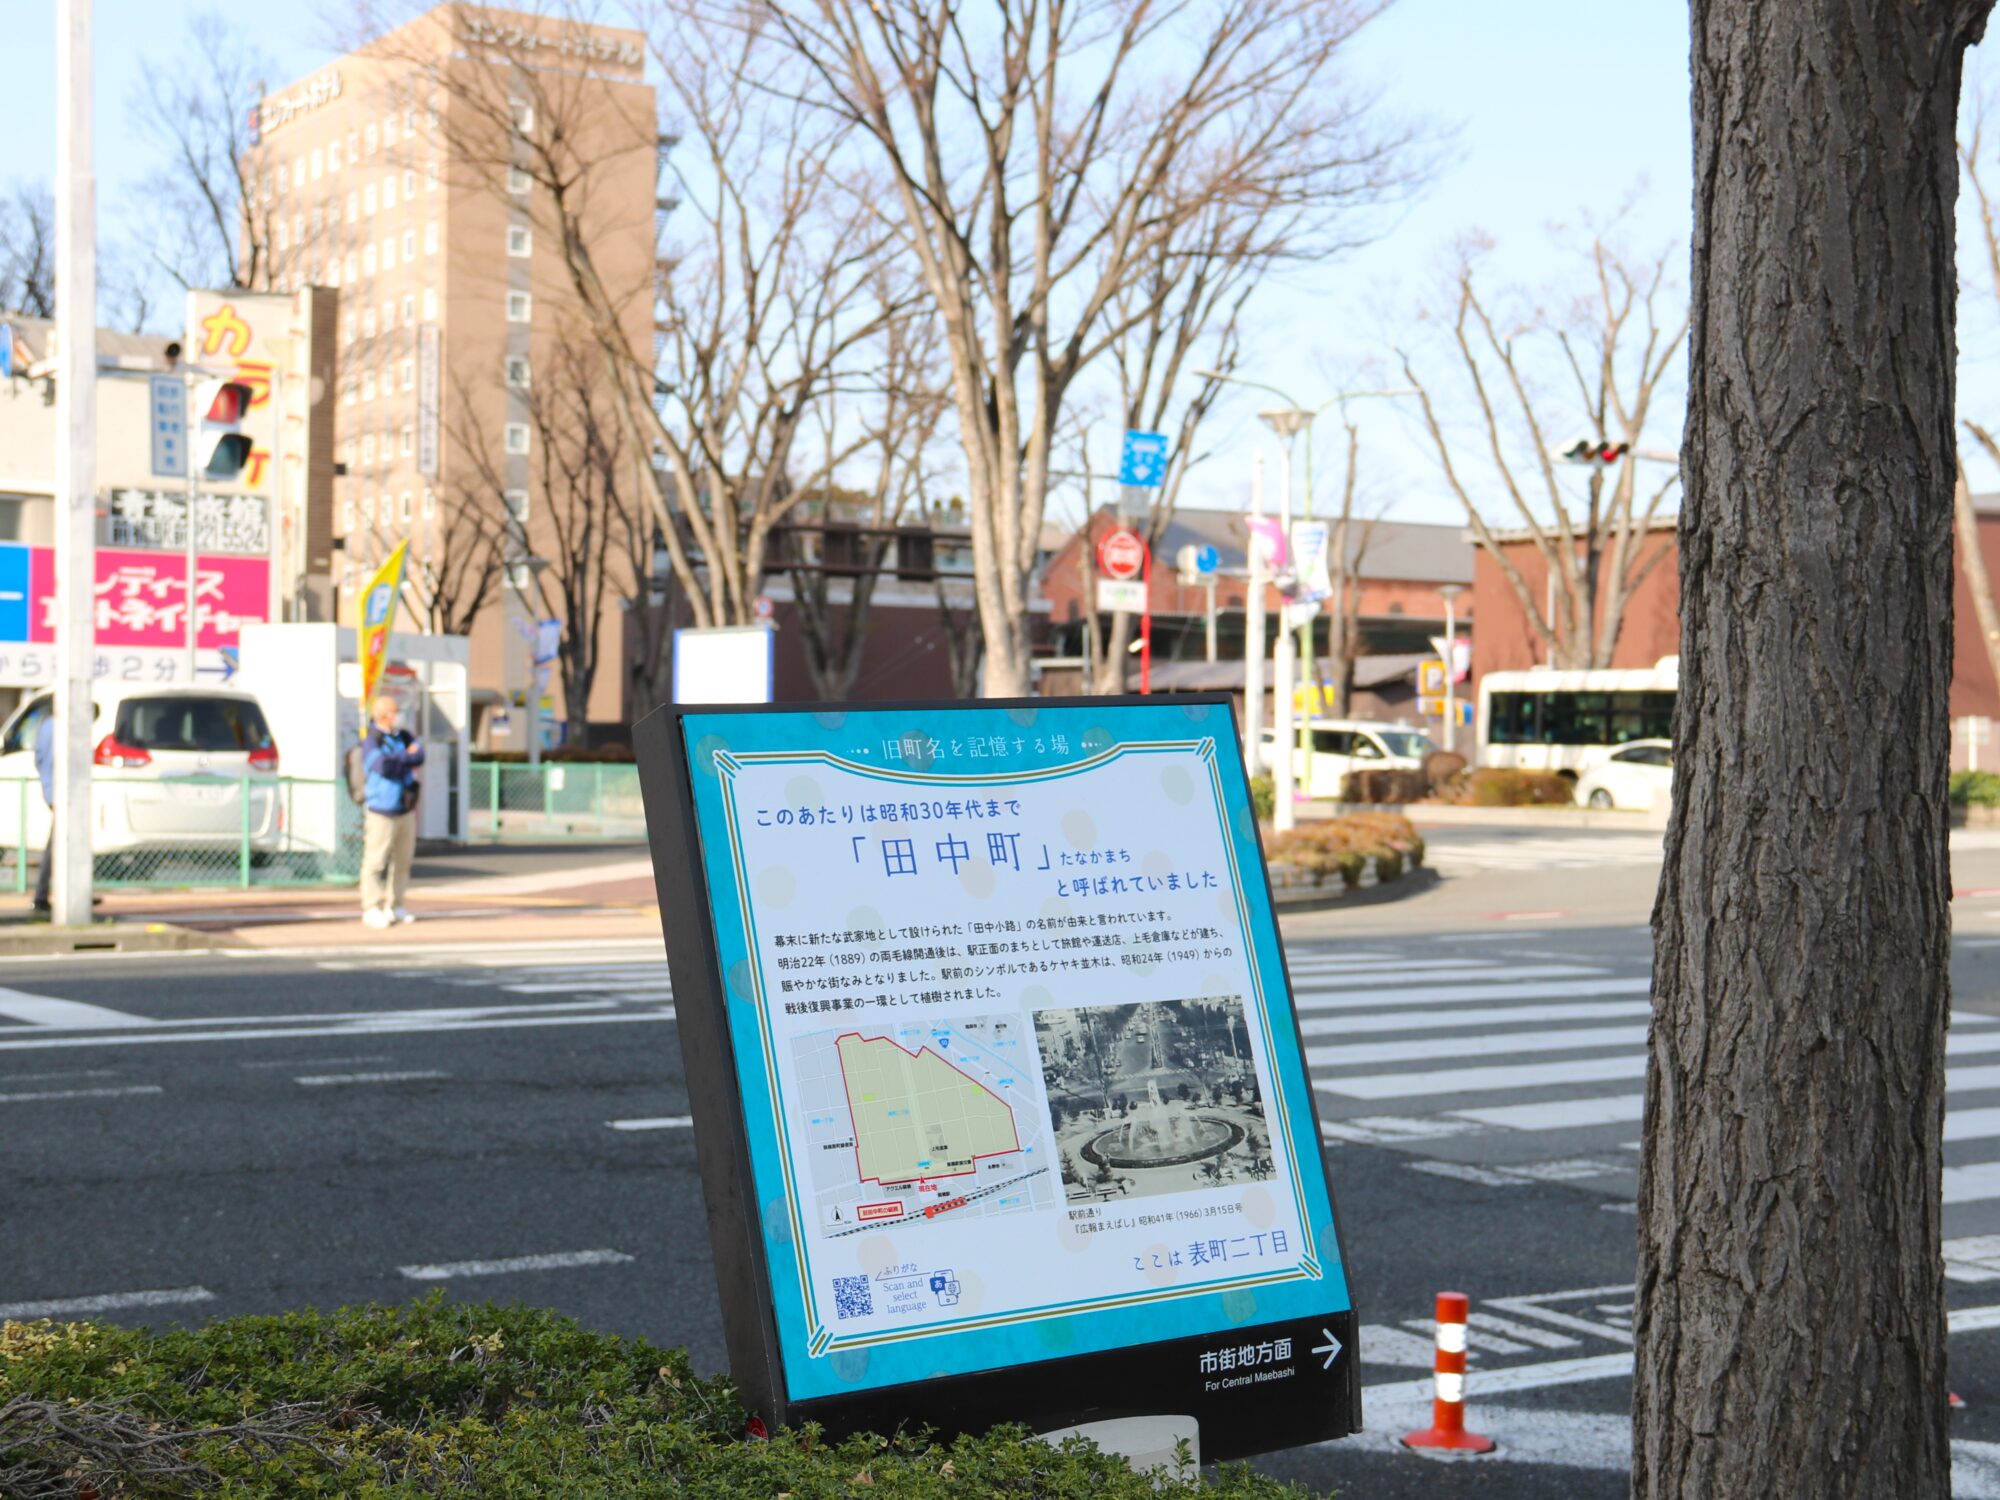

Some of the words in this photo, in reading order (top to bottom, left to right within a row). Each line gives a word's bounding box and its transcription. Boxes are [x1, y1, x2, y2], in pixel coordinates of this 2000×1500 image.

[202, 304, 275, 487] カラ
[881, 734, 1070, 761] 旧町名を記憶する場
[756, 799, 1022, 827] このあたりは昭和30年代まで
[1060, 848, 1131, 867] たなかまち
[1057, 870, 1219, 898] と呼ばれていました
[1068, 1207, 1102, 1220] 駅前通り
[883, 1263, 918, 1275] ふりがな
[883, 1281, 905, 1293] Scan
[908, 1278, 924, 1289] and
[893, 1291, 918, 1302] select
[887, 1301, 927, 1314] language
[1200, 1338, 1292, 1374] 市街地方面
[1205, 1380, 1220, 1392] For
[1222, 1376, 1253, 1390] Central
[1254, 1366, 1295, 1383] Maebashi
